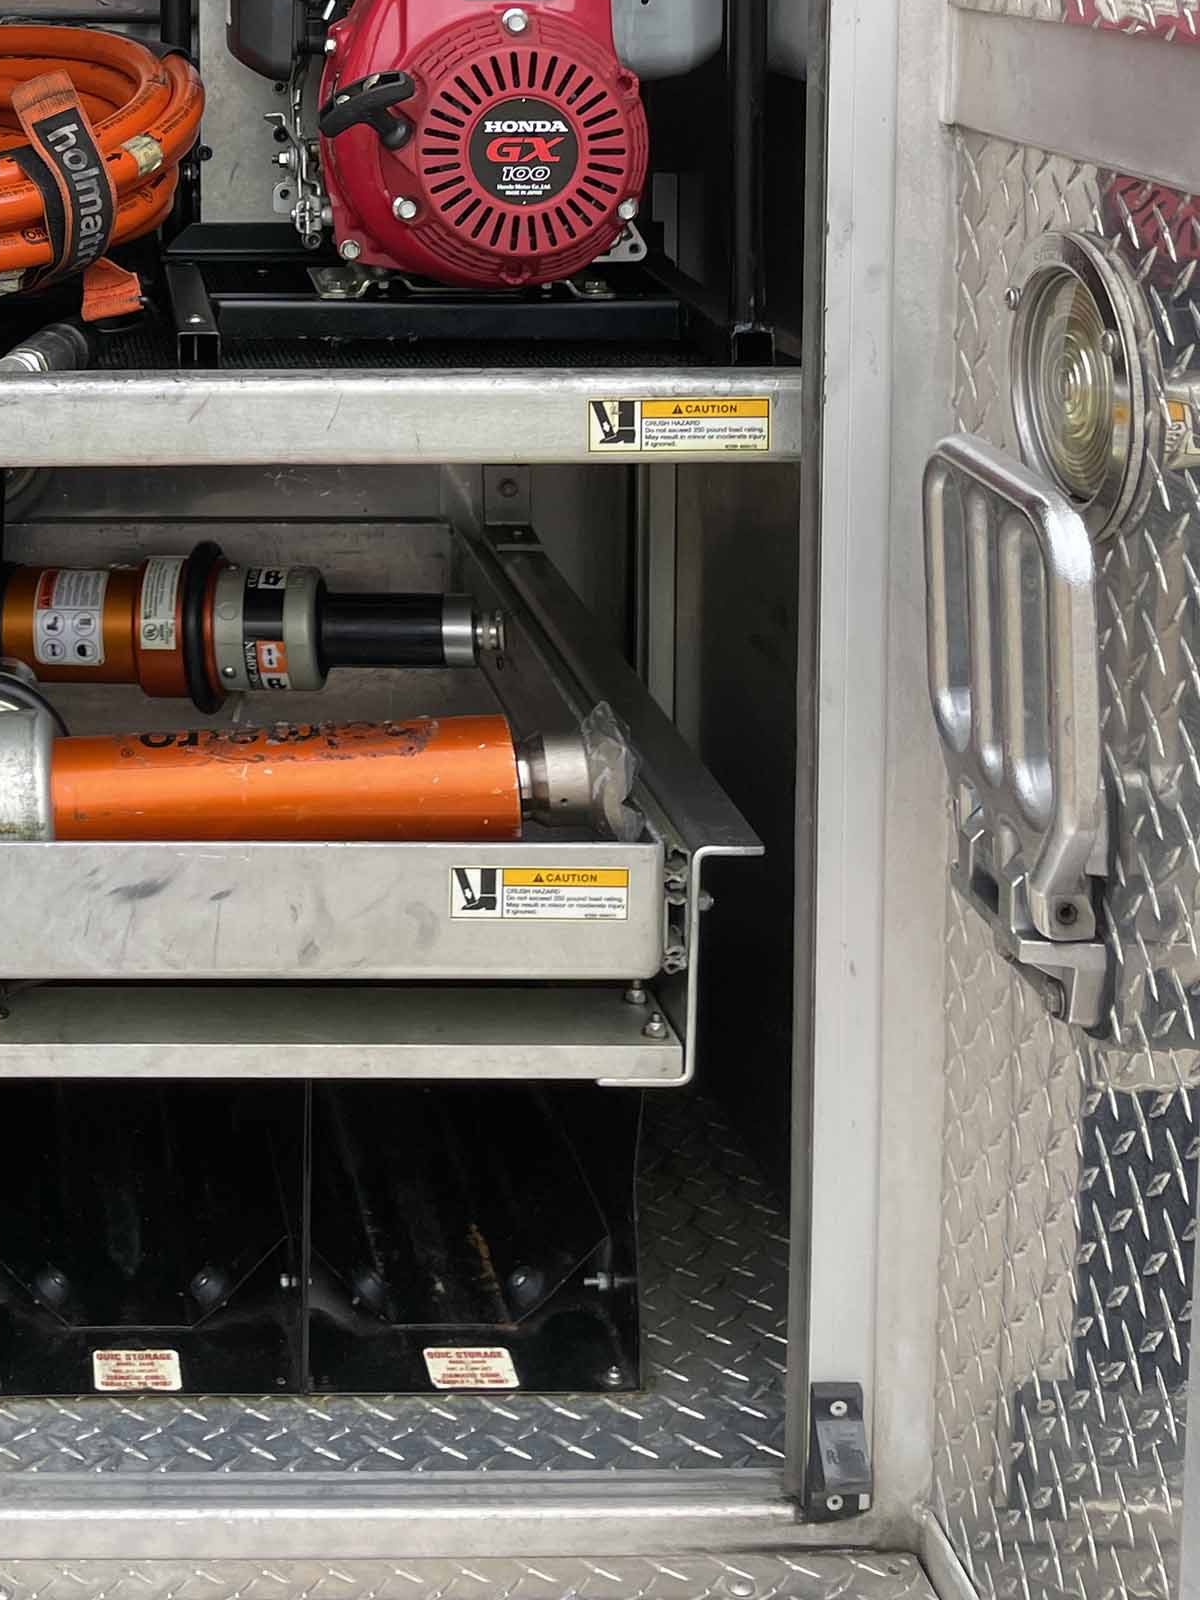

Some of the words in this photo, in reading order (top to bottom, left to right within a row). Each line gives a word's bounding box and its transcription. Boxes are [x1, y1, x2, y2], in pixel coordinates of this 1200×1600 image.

[484, 120, 569, 133] HONDA
[486, 136, 566, 162] GX
[502, 166, 551, 181] 100
[46, 123, 105, 266] holmatr
[685, 404, 737, 413] CAUTION
[546, 874, 598, 883] CAUTION
